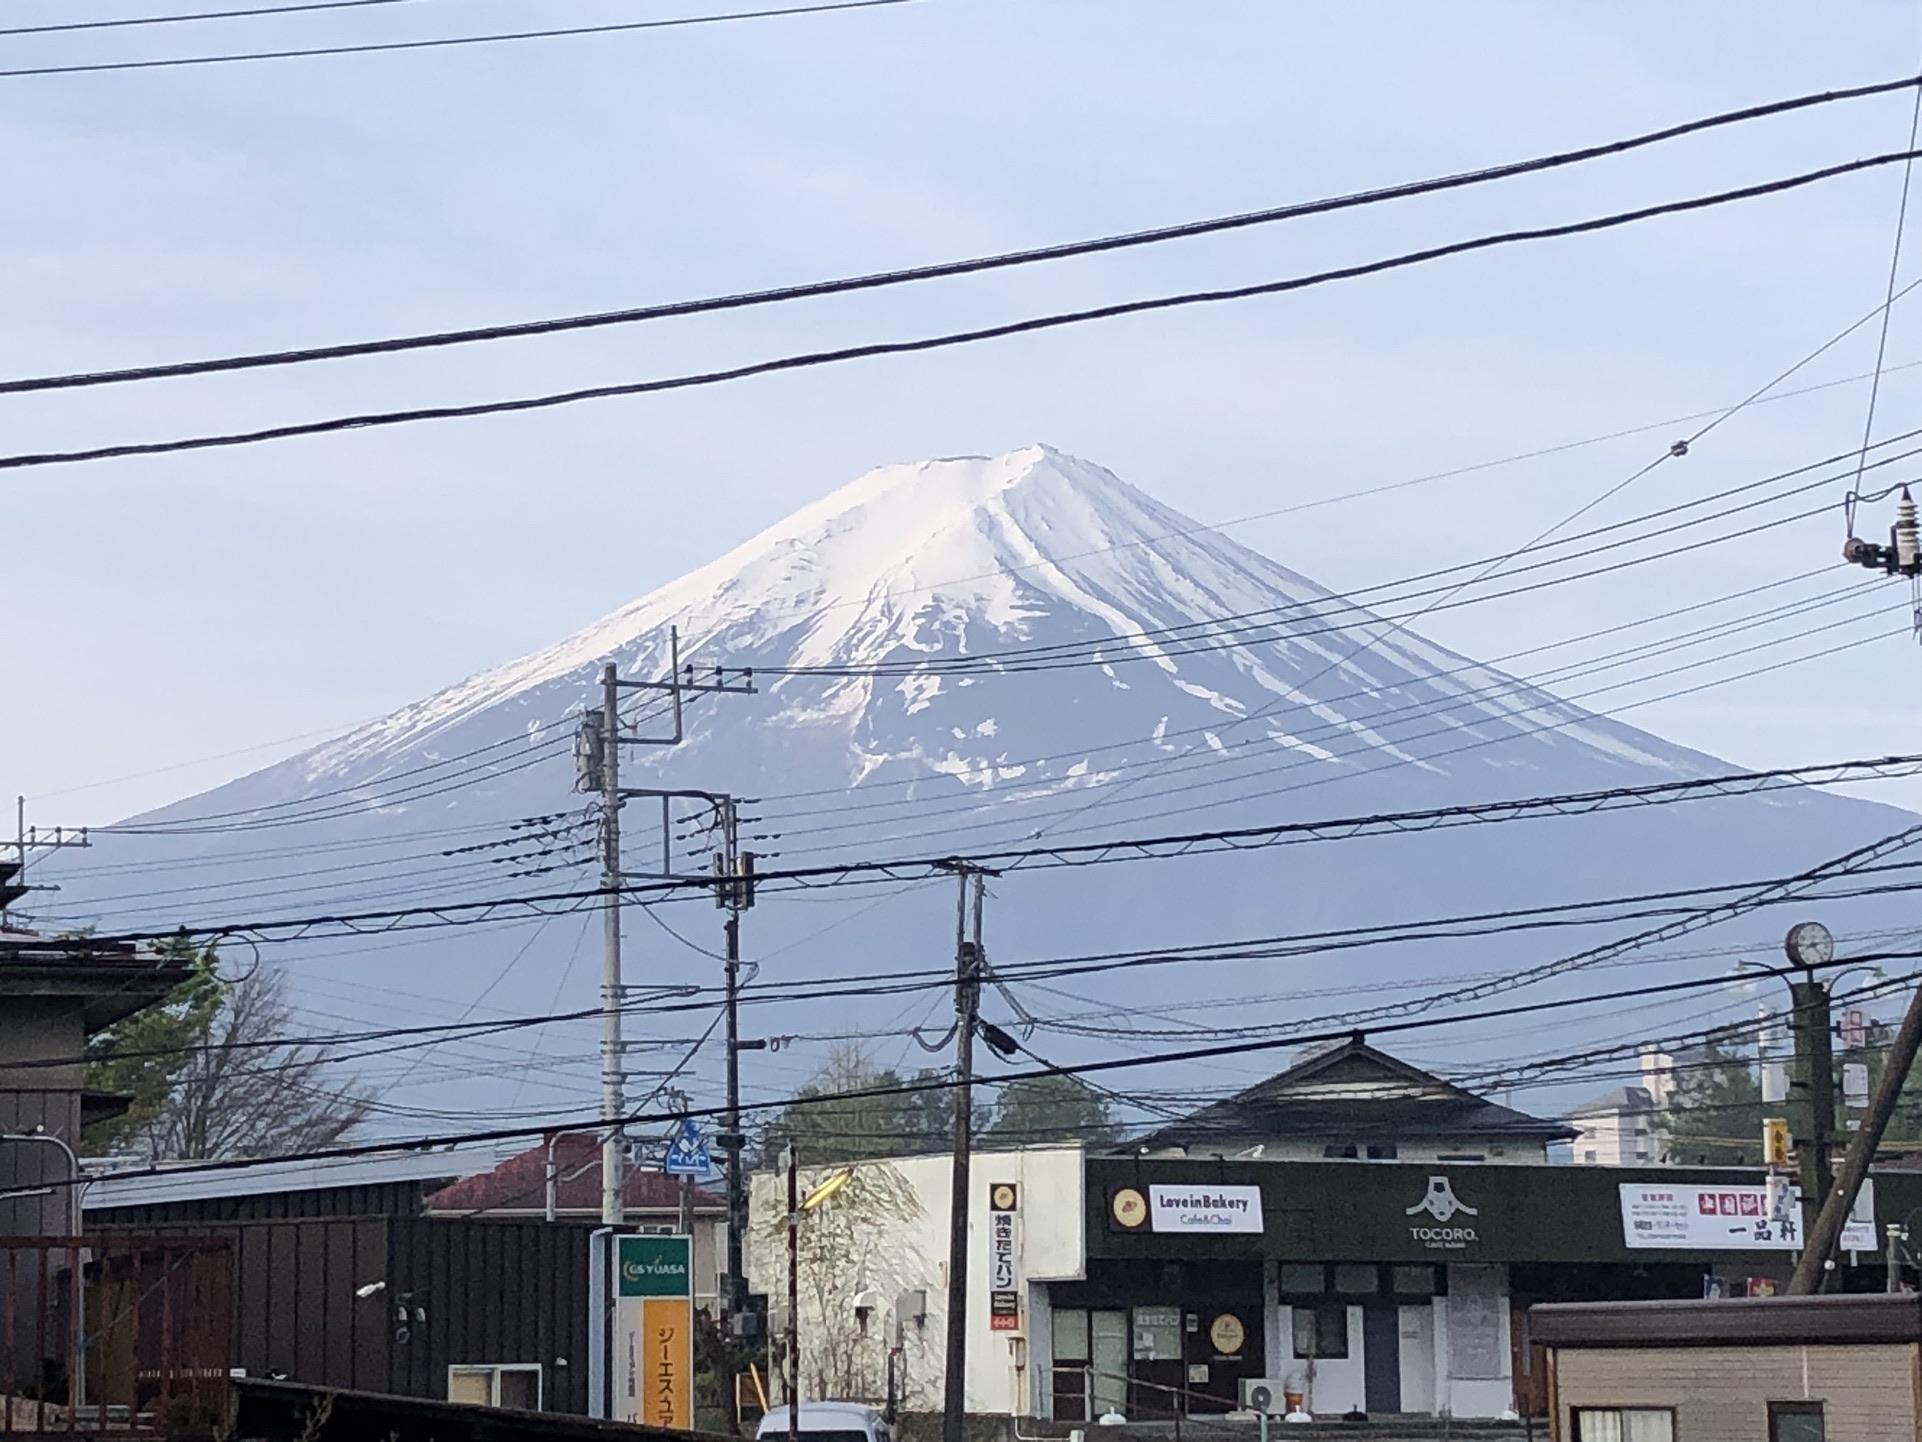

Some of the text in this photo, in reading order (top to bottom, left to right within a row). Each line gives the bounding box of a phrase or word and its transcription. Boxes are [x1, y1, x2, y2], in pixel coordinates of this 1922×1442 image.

[995, 1214, 1013, 1289] 焼きたてパン
